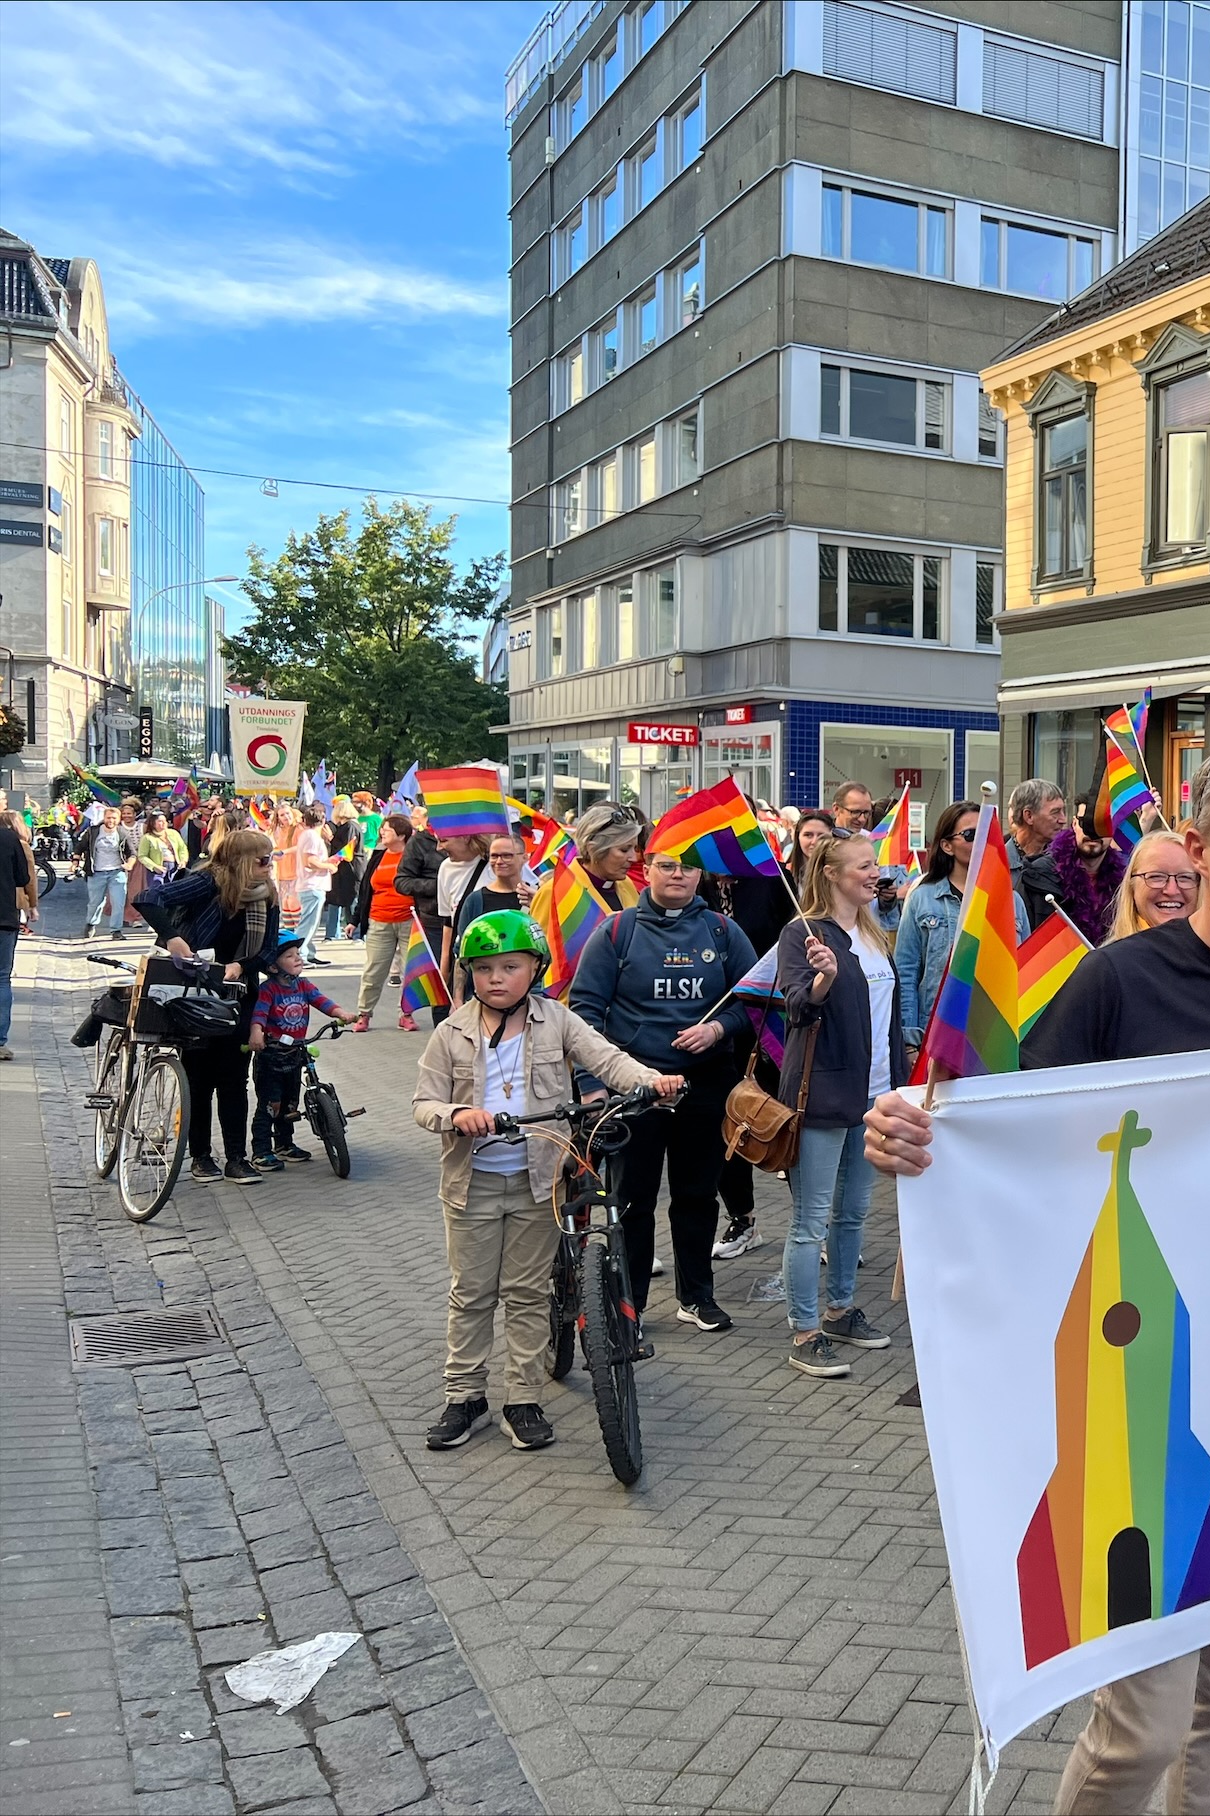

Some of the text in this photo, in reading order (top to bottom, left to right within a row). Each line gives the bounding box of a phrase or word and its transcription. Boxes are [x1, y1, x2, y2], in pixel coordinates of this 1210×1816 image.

[239, 707, 296, 717] UTDANNINGS
[241, 716, 293, 726] FORBUNDET
[141, 718, 151, 755] EGON
[634, 726, 693, 742] TICKET
[653, 977, 704, 1000] ELSK
